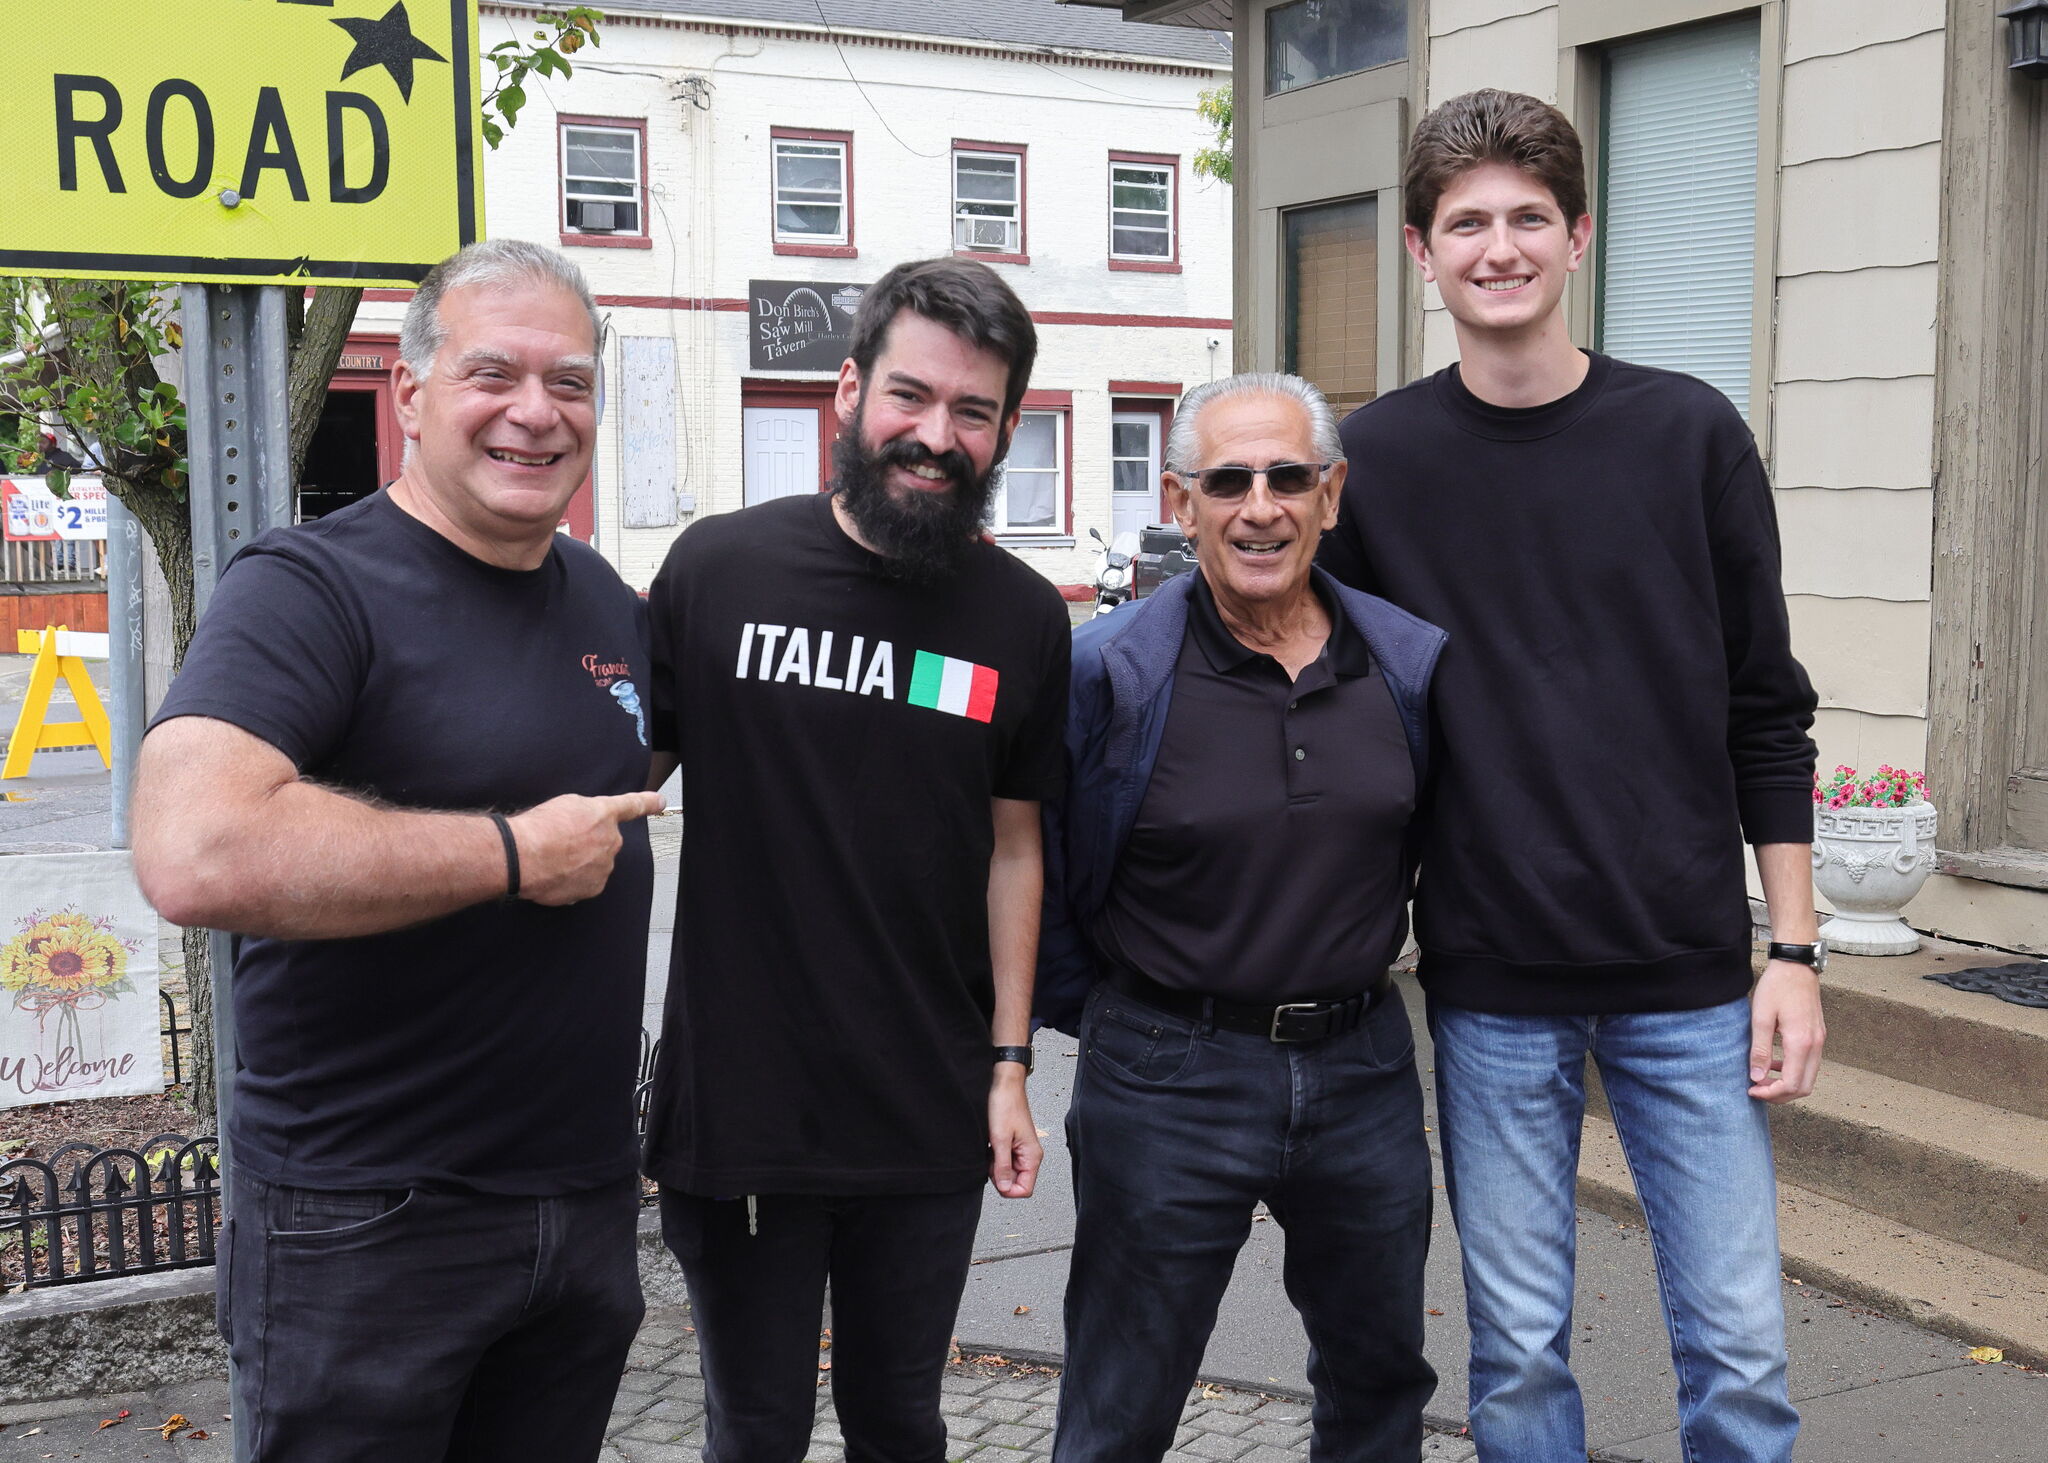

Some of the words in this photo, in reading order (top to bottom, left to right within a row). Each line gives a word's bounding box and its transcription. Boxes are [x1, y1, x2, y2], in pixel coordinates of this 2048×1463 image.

[54, 73, 390, 204] ROAD
[756, 298, 790, 317] Don
[793, 304, 820, 318] Birch's
[760, 322, 791, 340] Saw
[794, 320, 813, 335] Mill
[763, 339, 806, 361] Tavern
[340, 356, 377, 368] COUNTRY
[57, 506, 83, 529] $2
[736, 623, 894, 700] ITALIA
[0, 1046, 136, 1094] Welcome
